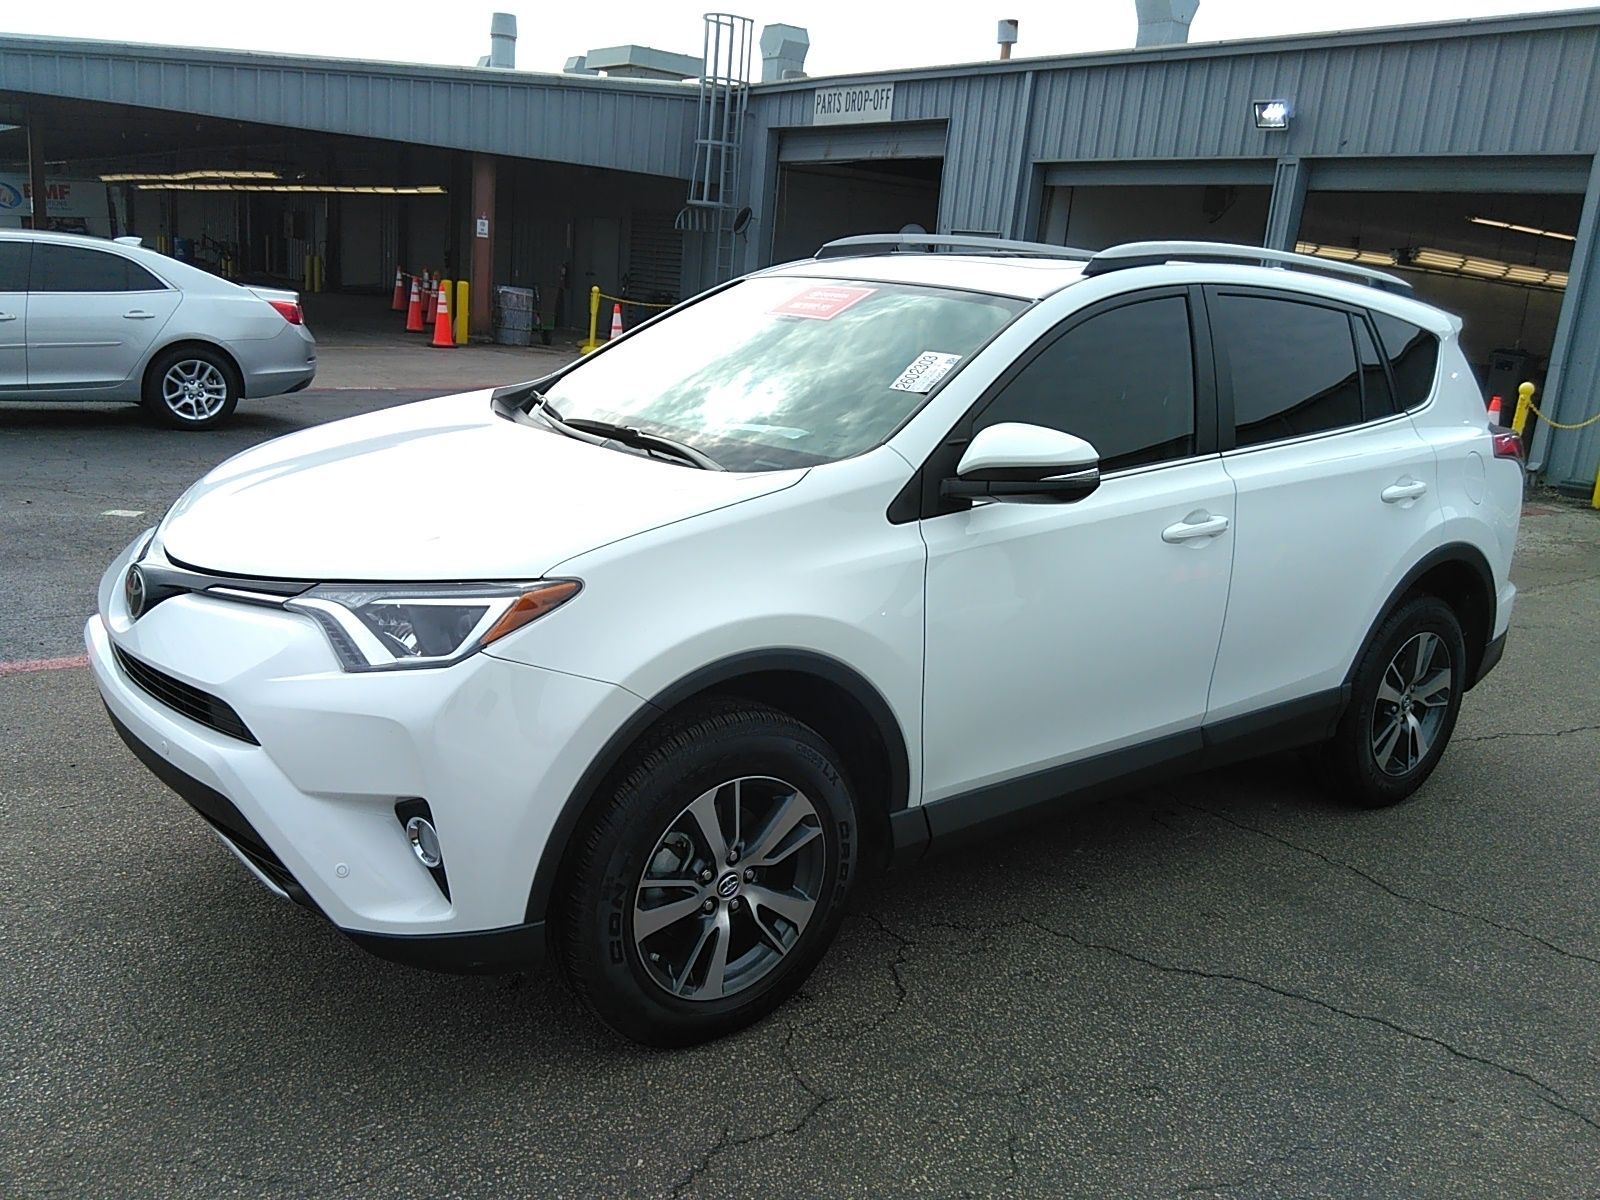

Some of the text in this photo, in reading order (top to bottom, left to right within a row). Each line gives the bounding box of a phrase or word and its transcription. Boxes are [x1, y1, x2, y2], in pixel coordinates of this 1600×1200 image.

[816, 88, 891, 114] PARTS DROP-OFF
[895, 355, 938, 389] 2602303
